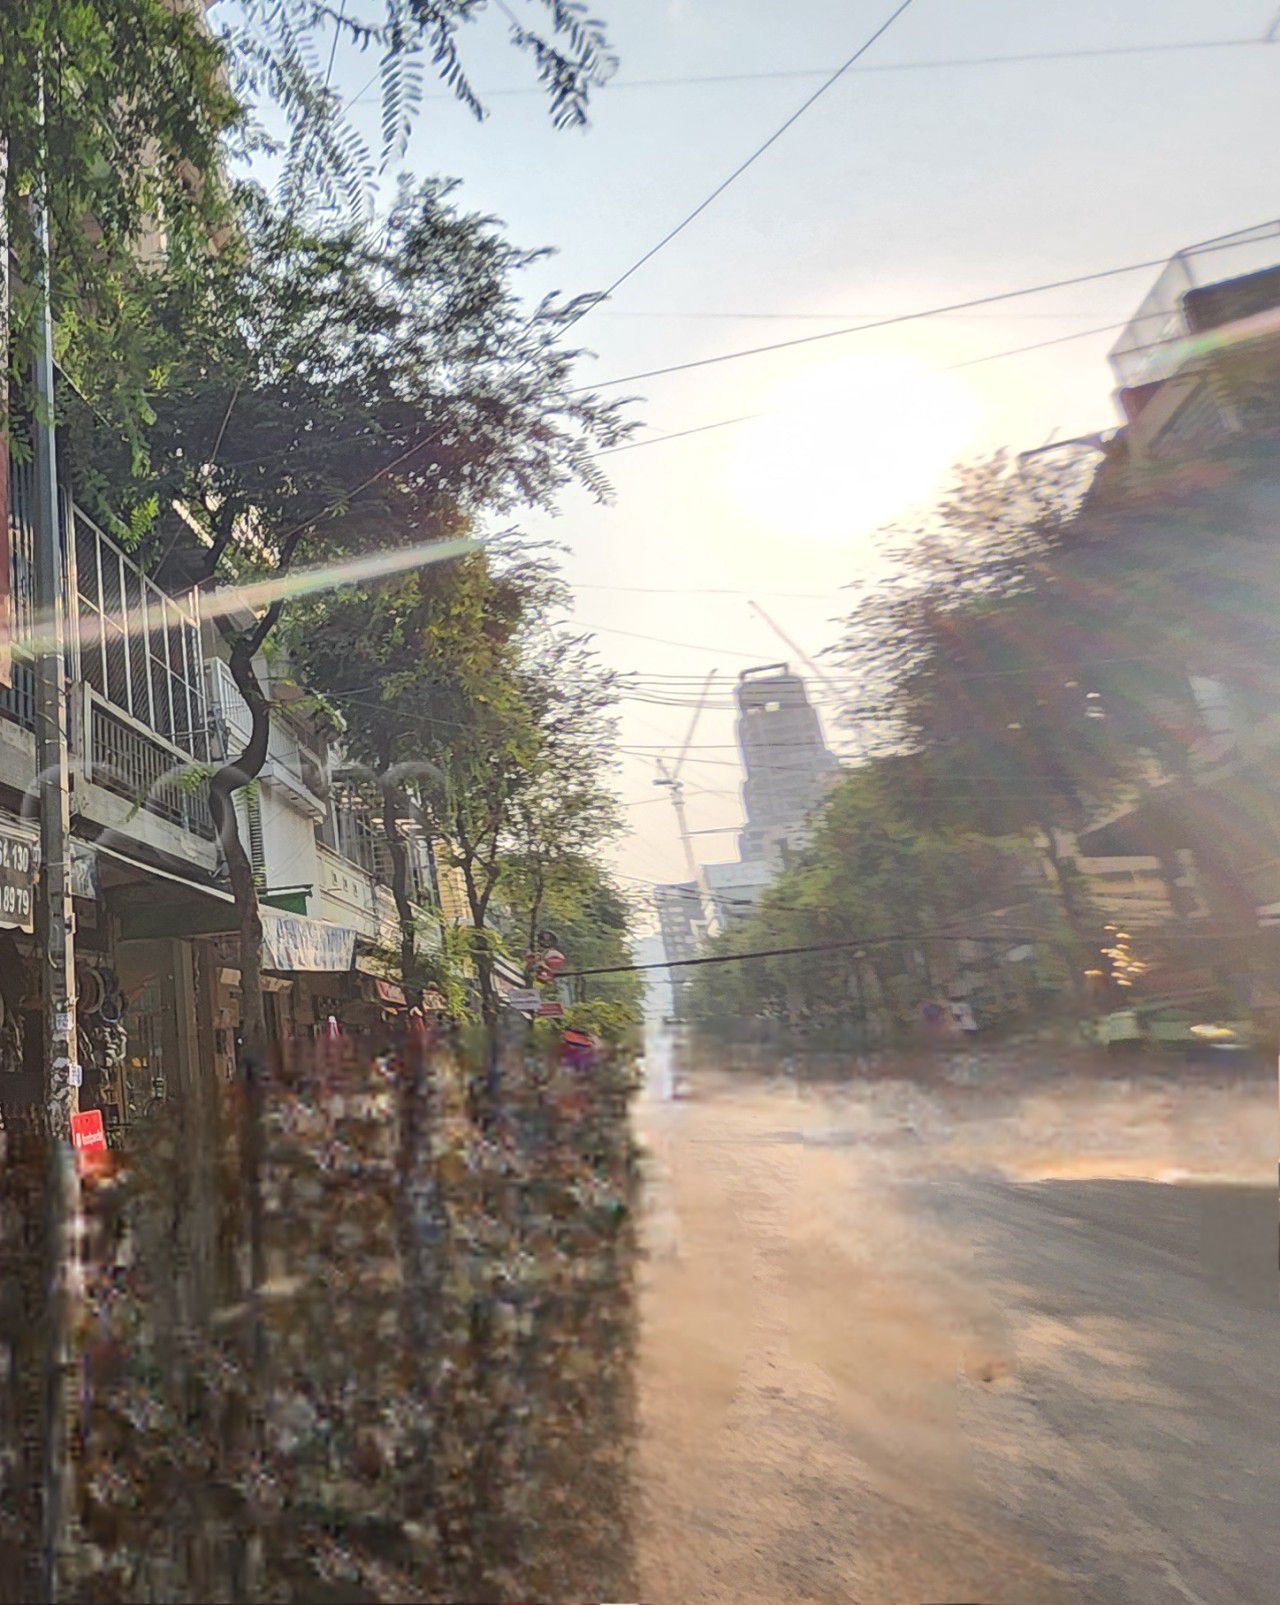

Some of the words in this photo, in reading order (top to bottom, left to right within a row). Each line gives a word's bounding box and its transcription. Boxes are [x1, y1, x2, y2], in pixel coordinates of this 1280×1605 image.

[12, 844, 29, 873] 130
[3, 885, 16, 914] 89
[16, 888, 30, 916] 79
